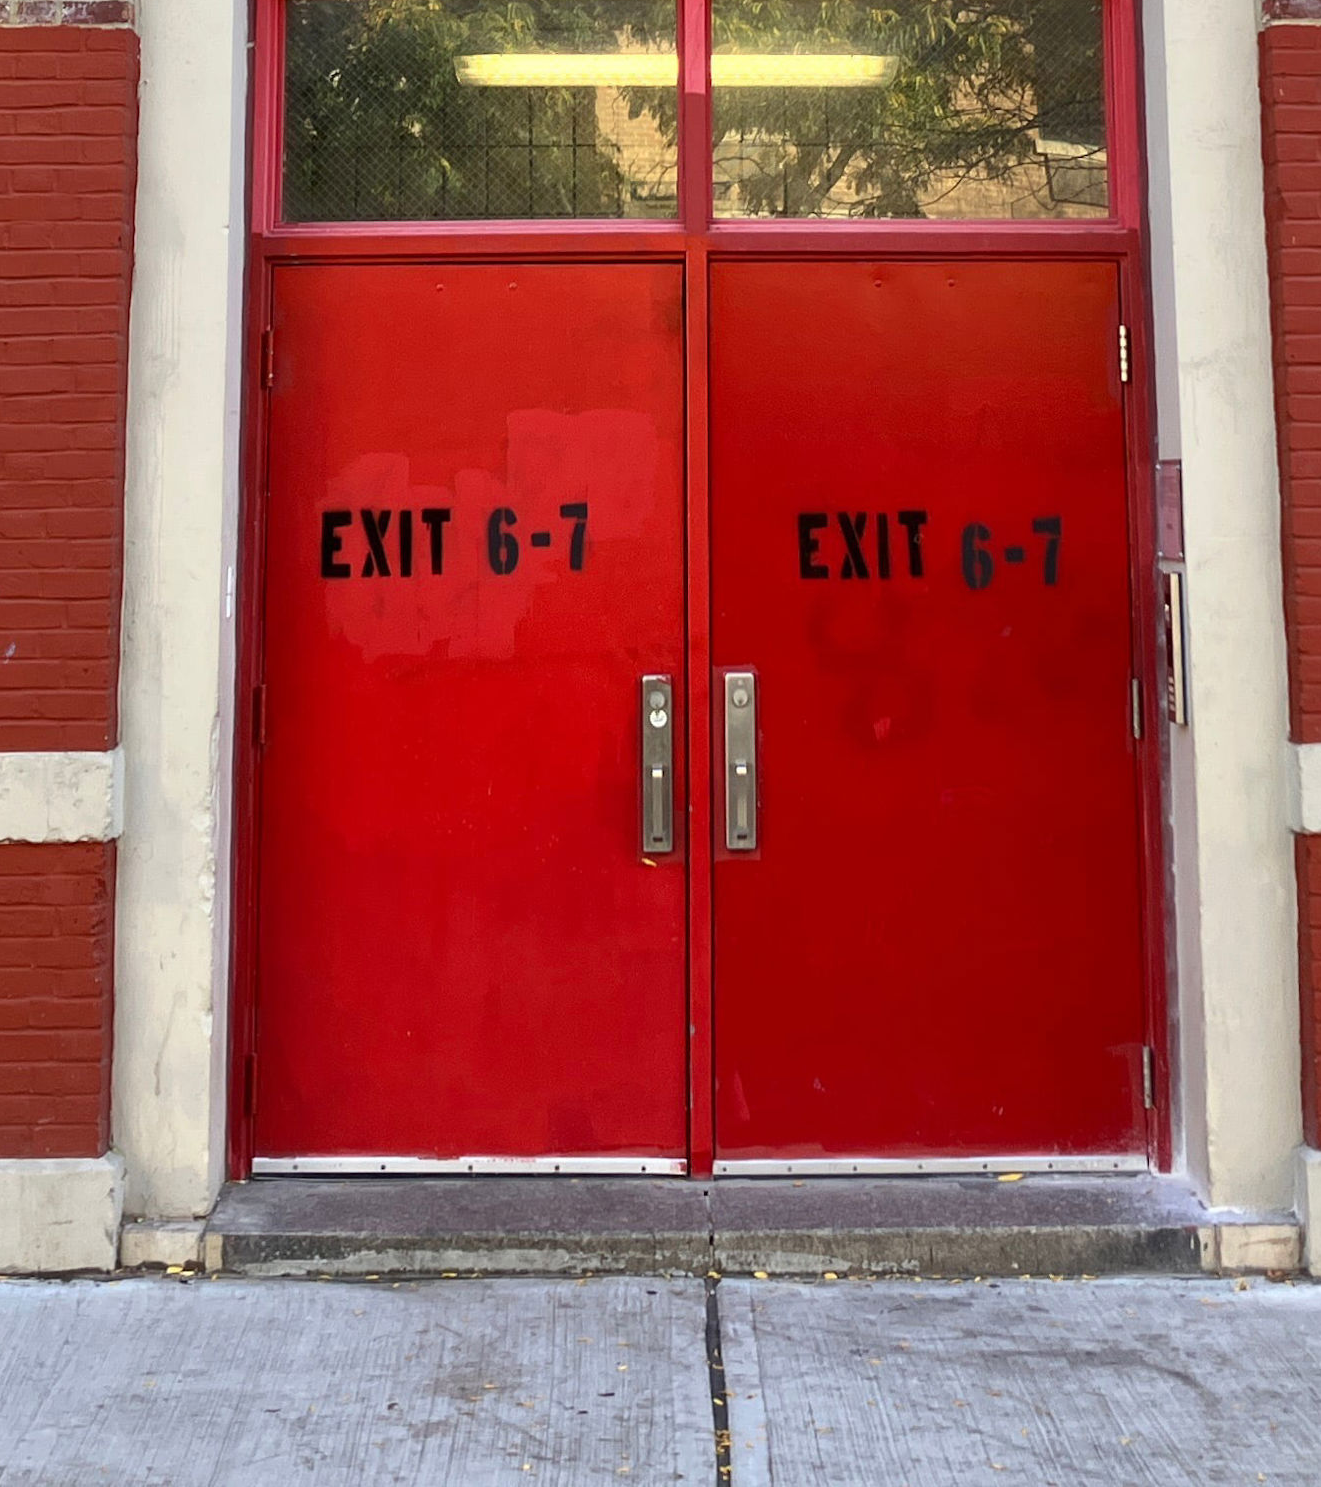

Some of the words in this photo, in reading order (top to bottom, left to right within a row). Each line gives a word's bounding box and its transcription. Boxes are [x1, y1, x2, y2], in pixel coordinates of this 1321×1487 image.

[320, 508, 453, 580] EXIT
[487, 502, 590, 575] 6-7
[797, 510, 928, 581] EXIT
[961, 515, 1063, 590] 6-7
